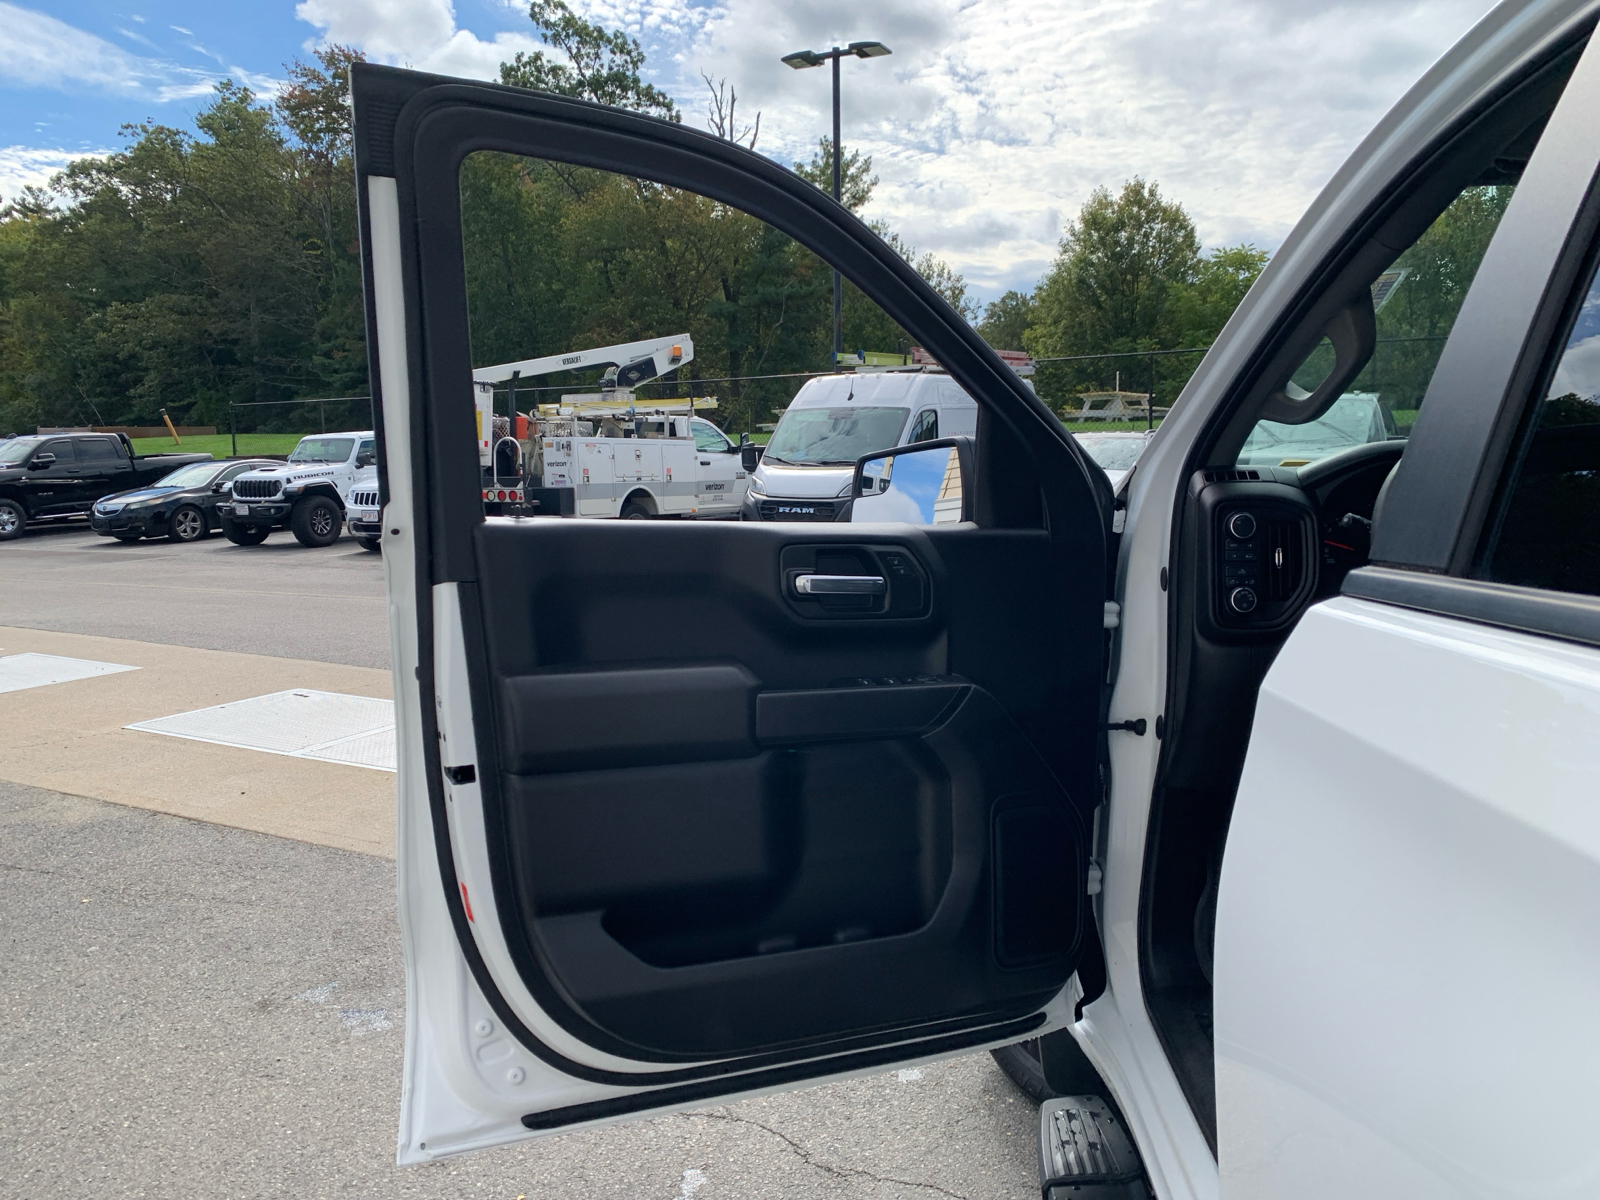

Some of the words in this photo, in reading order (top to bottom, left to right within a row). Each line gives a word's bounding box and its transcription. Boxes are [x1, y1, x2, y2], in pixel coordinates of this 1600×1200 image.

[546, 460, 567, 468] verizon
[293, 471, 334, 480] RUBICON
[704, 482, 725, 491] verizon
[778, 506, 815, 514] RAM
